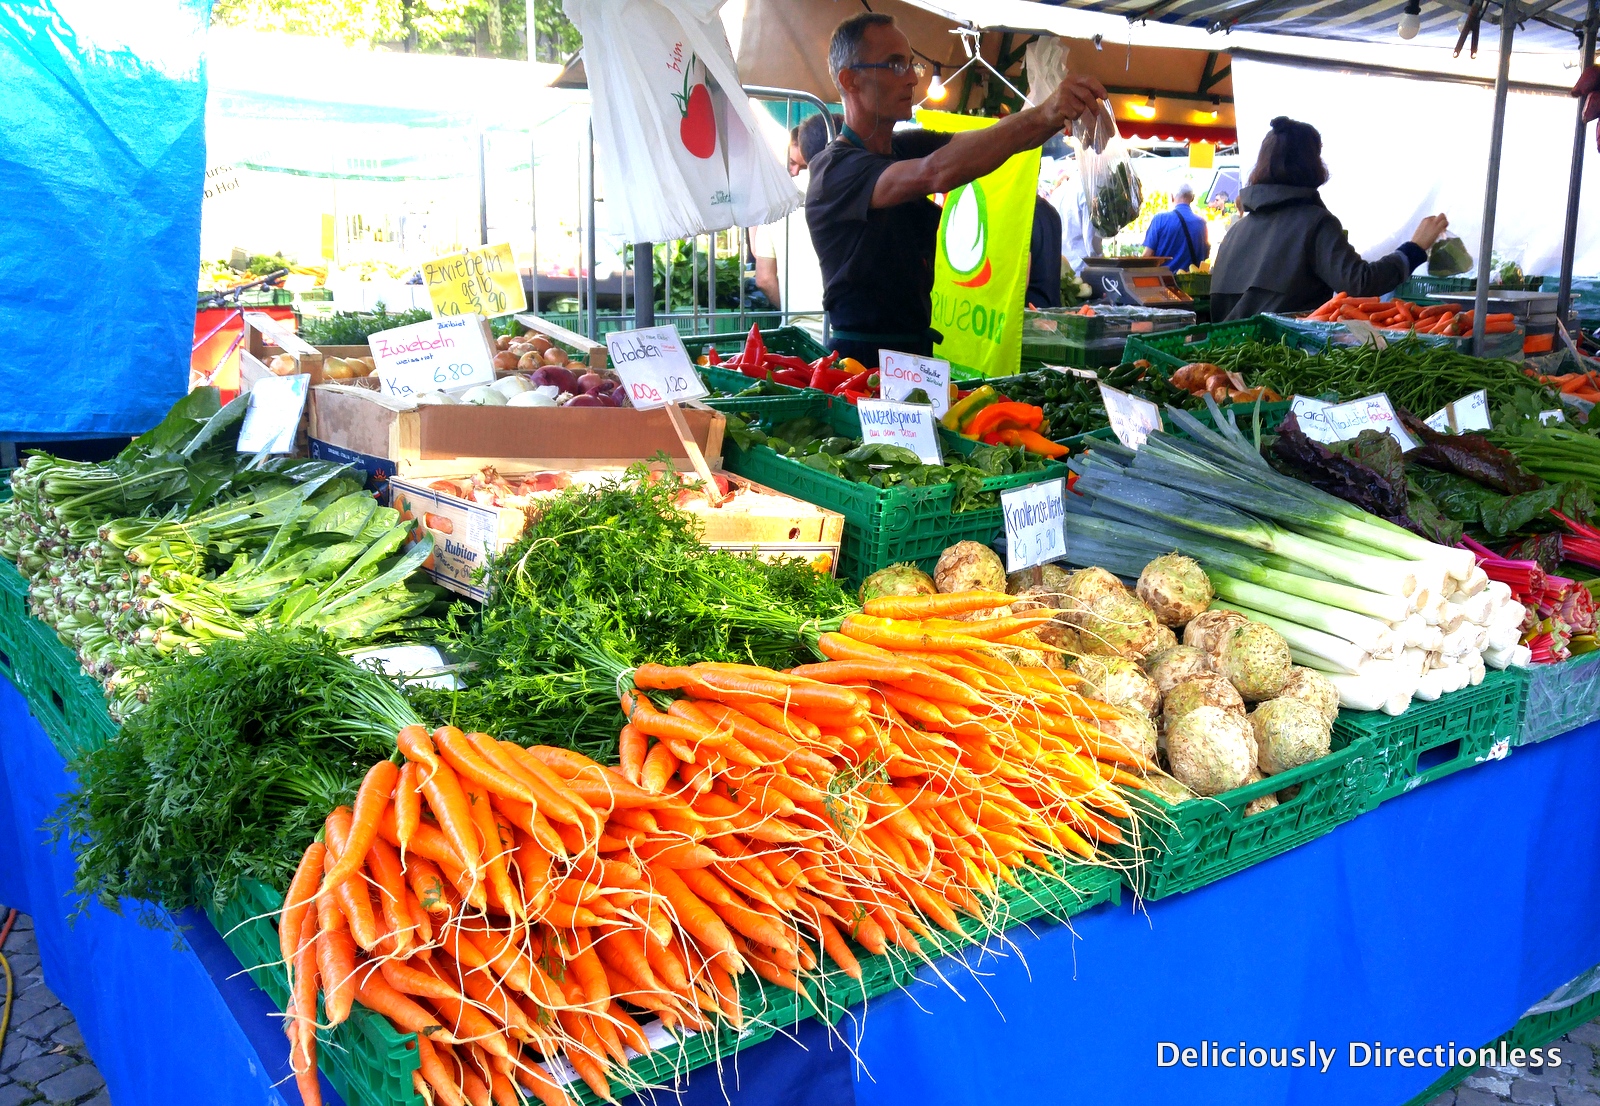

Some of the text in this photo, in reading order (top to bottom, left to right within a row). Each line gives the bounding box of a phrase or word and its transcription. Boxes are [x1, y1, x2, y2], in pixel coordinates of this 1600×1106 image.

[425, 251, 503, 286] Zwiebeln
[376, 331, 455, 358] Zwiebeln
[885, 356, 922, 383] Corno
[884, 386, 896, 400] K
[860, 406, 922, 431] Wurzelspinat
[445, 538, 478, 562] Rubitar
